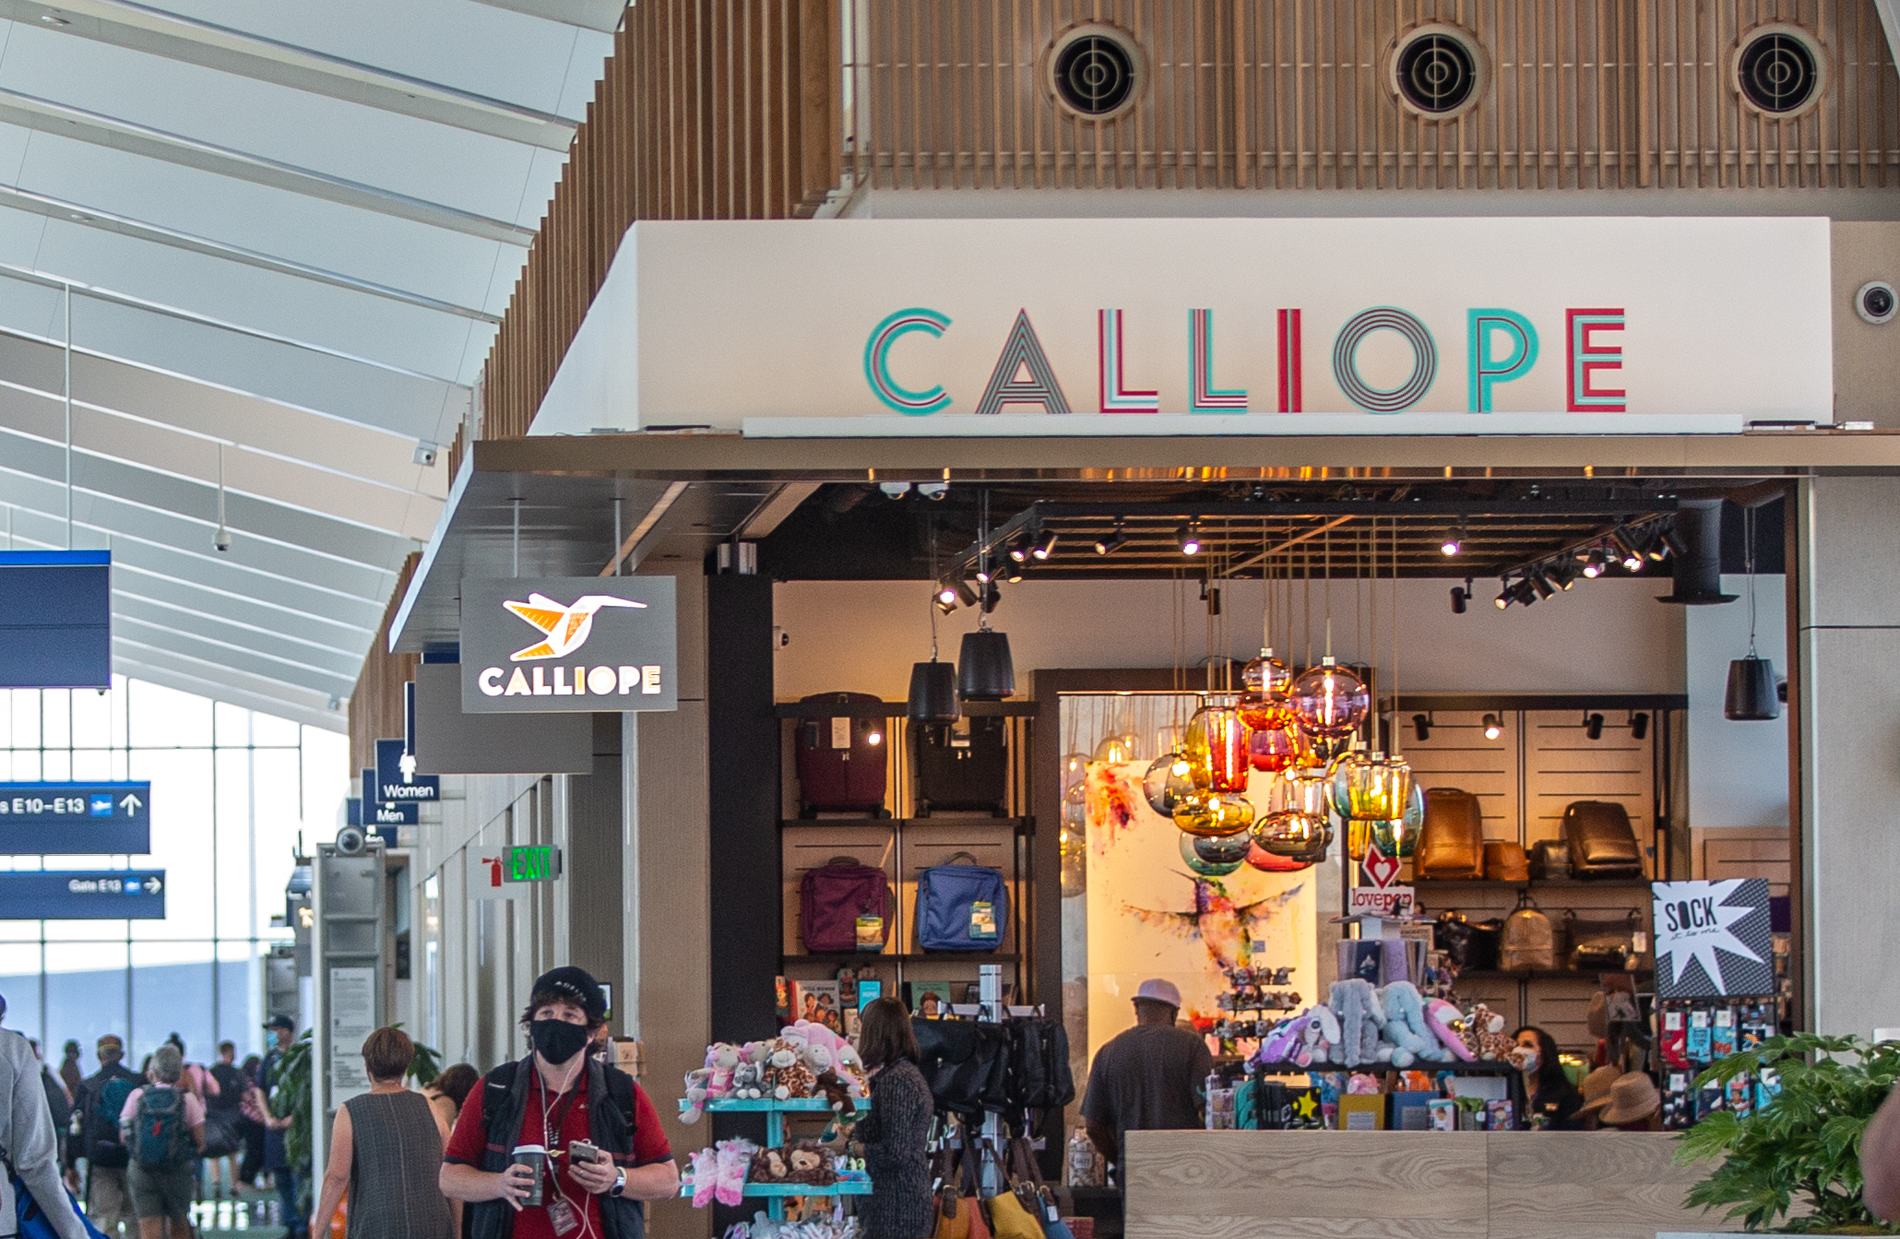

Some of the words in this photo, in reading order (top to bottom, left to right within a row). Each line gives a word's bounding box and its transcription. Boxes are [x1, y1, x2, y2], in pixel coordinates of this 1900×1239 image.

[863, 305, 1627, 416] CALLIOPE
[477, 665, 662, 697] CALLIOPE
[383, 784, 435, 799] Women
[376, 809, 405, 823] Men
[511, 846, 552, 881] EXIT
[68, 879, 97, 894] Gate
[99, 879, 122, 893] E13
[1664, 896, 1718, 932] SOCK
